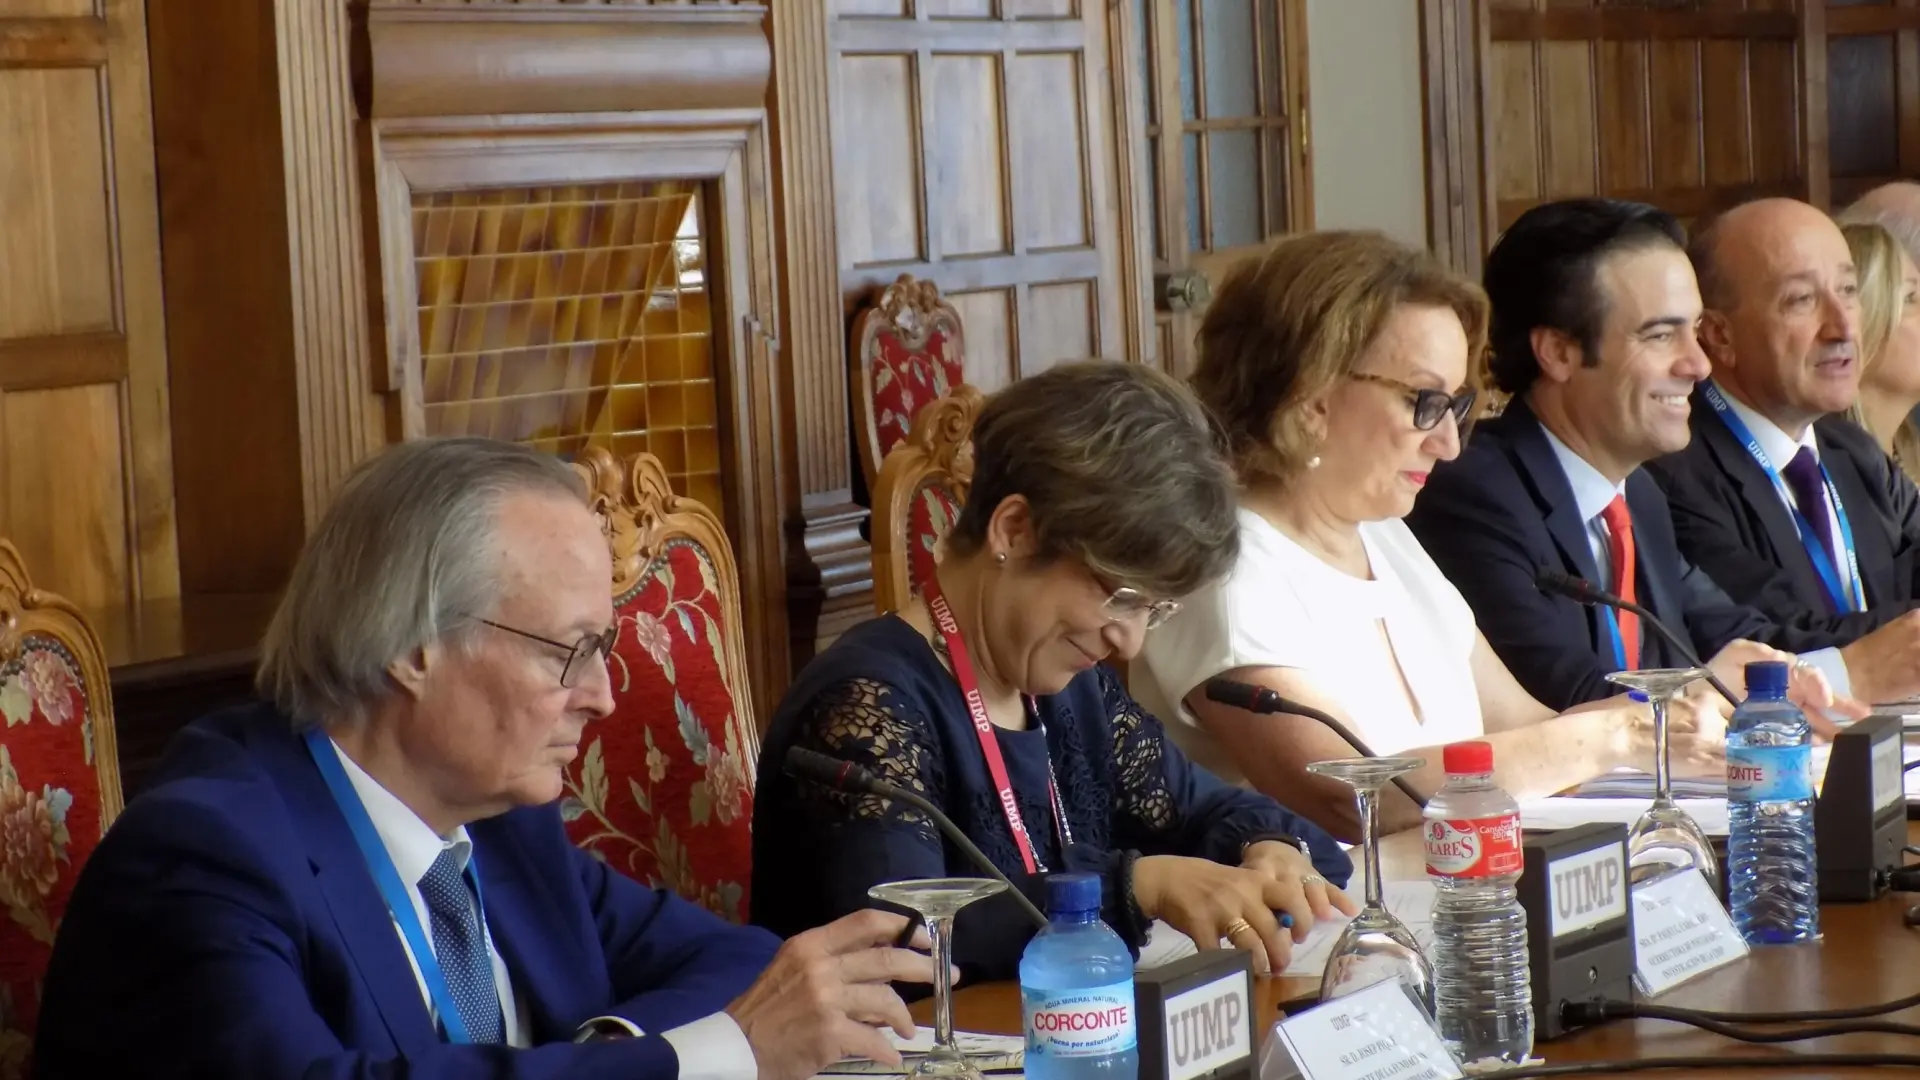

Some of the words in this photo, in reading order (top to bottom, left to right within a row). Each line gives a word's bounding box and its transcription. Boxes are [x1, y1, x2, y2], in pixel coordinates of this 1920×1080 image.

[1706, 386, 1727, 413] UIMP
[1747, 440, 1771, 469] UIMP
[931, 594, 957, 633] UIMP
[967, 688, 990, 733] UIMP
[1000, 787, 1021, 833] UIMP
[1555, 857, 1619, 919] UIMP
[1045, 1001, 1060, 1010] AGUA
[1092, 995, 1118, 1004] NATURAL
[1034, 1006, 1127, 1031] CORCONTE
[1170, 991, 1241, 1068] UIMP
[1330, 1013, 1351, 1031] UIMP
[1072, 1041, 1083, 1049] por
[1391, 1052, 1428, 1074] FUNDACIN
